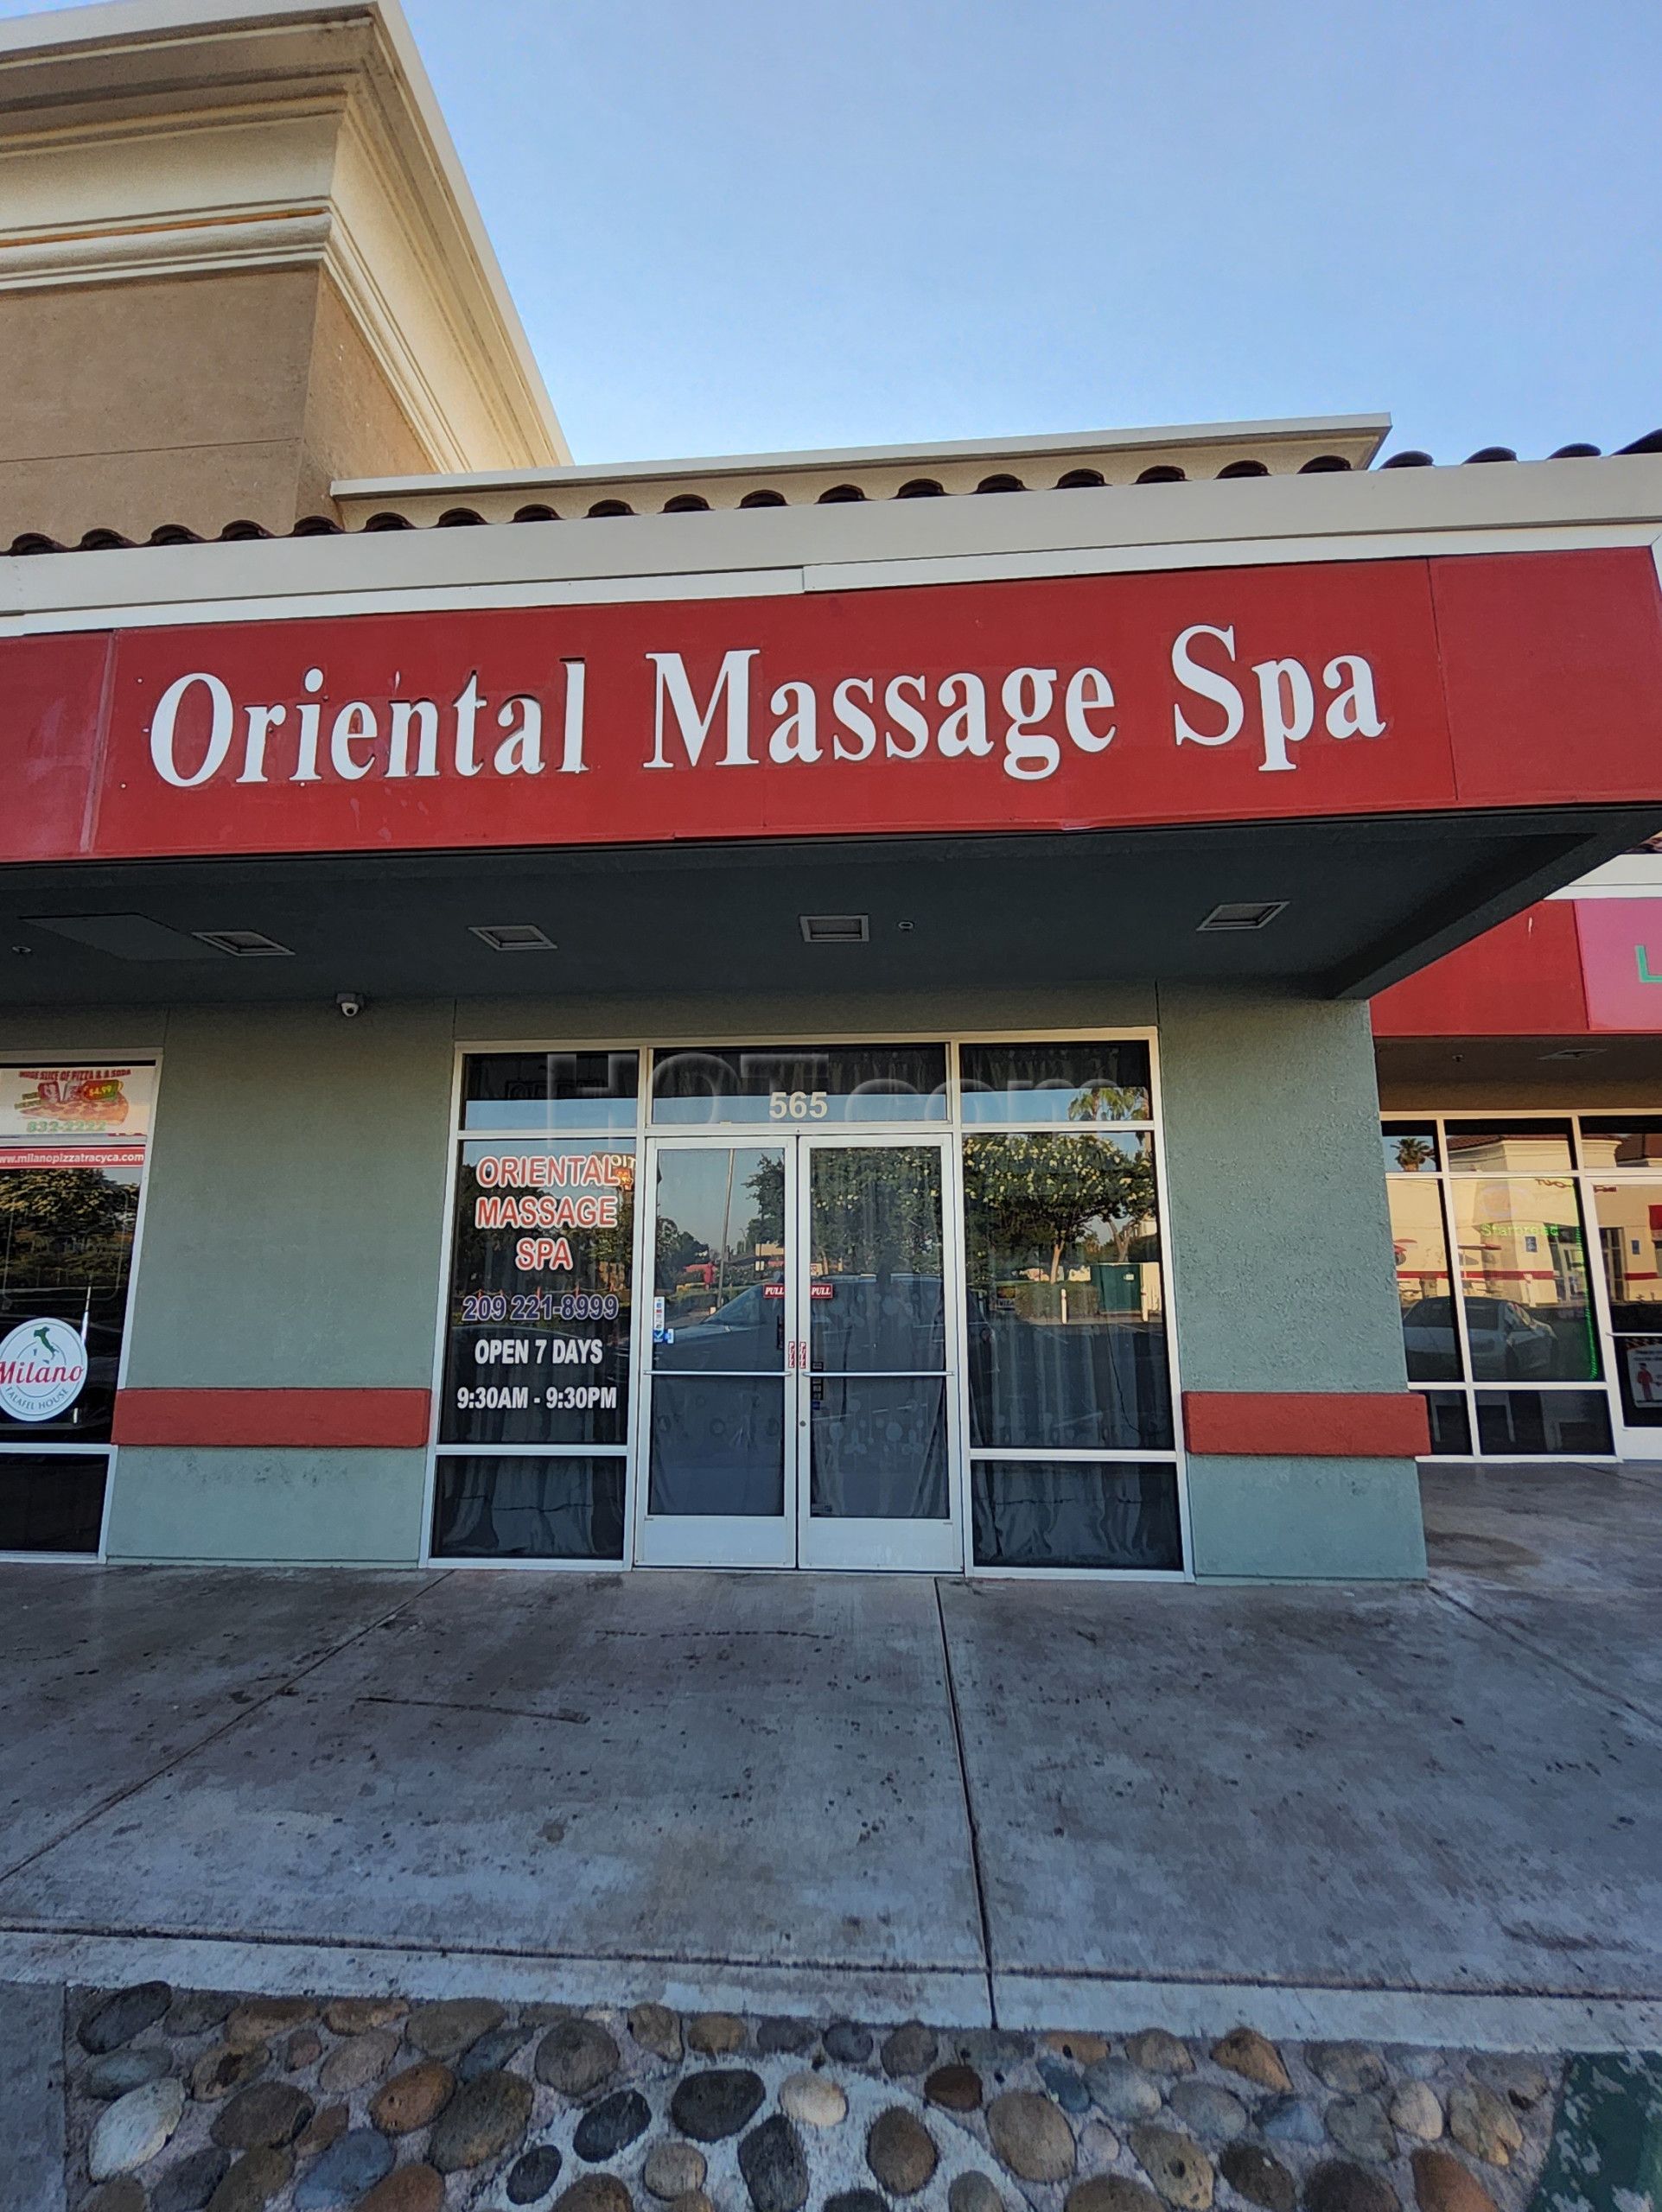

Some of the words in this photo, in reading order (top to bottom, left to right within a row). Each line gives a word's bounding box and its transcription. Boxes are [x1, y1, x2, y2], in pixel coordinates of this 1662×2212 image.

[150, 660, 589, 787] Oriental
[643, 649, 1117, 780] Massage
[1171, 625, 1385, 772] Spa
[769, 1091, 828, 1119] 565
[476, 1155, 621, 1187] ORIENTAL
[475, 1196, 618, 1229] MASSAGE
[515, 1237, 573, 1270] SPA
[765, 1287, 784, 1295] PULL
[812, 1287, 831, 1295] PULL
[462, 1295, 506, 1321] 209
[510, 1294, 619, 1320] 221-8999
[475, 1339, 529, 1364] OPEN
[535, 1340, 547, 1363] 7
[552, 1339, 603, 1364] DAYS
[0, 1361, 84, 1384] Milano
[38, 1388, 68, 1409] HOUSE
[456, 1387, 528, 1409] 9:30AM
[545, 1387, 617, 1409] 9:30PM
